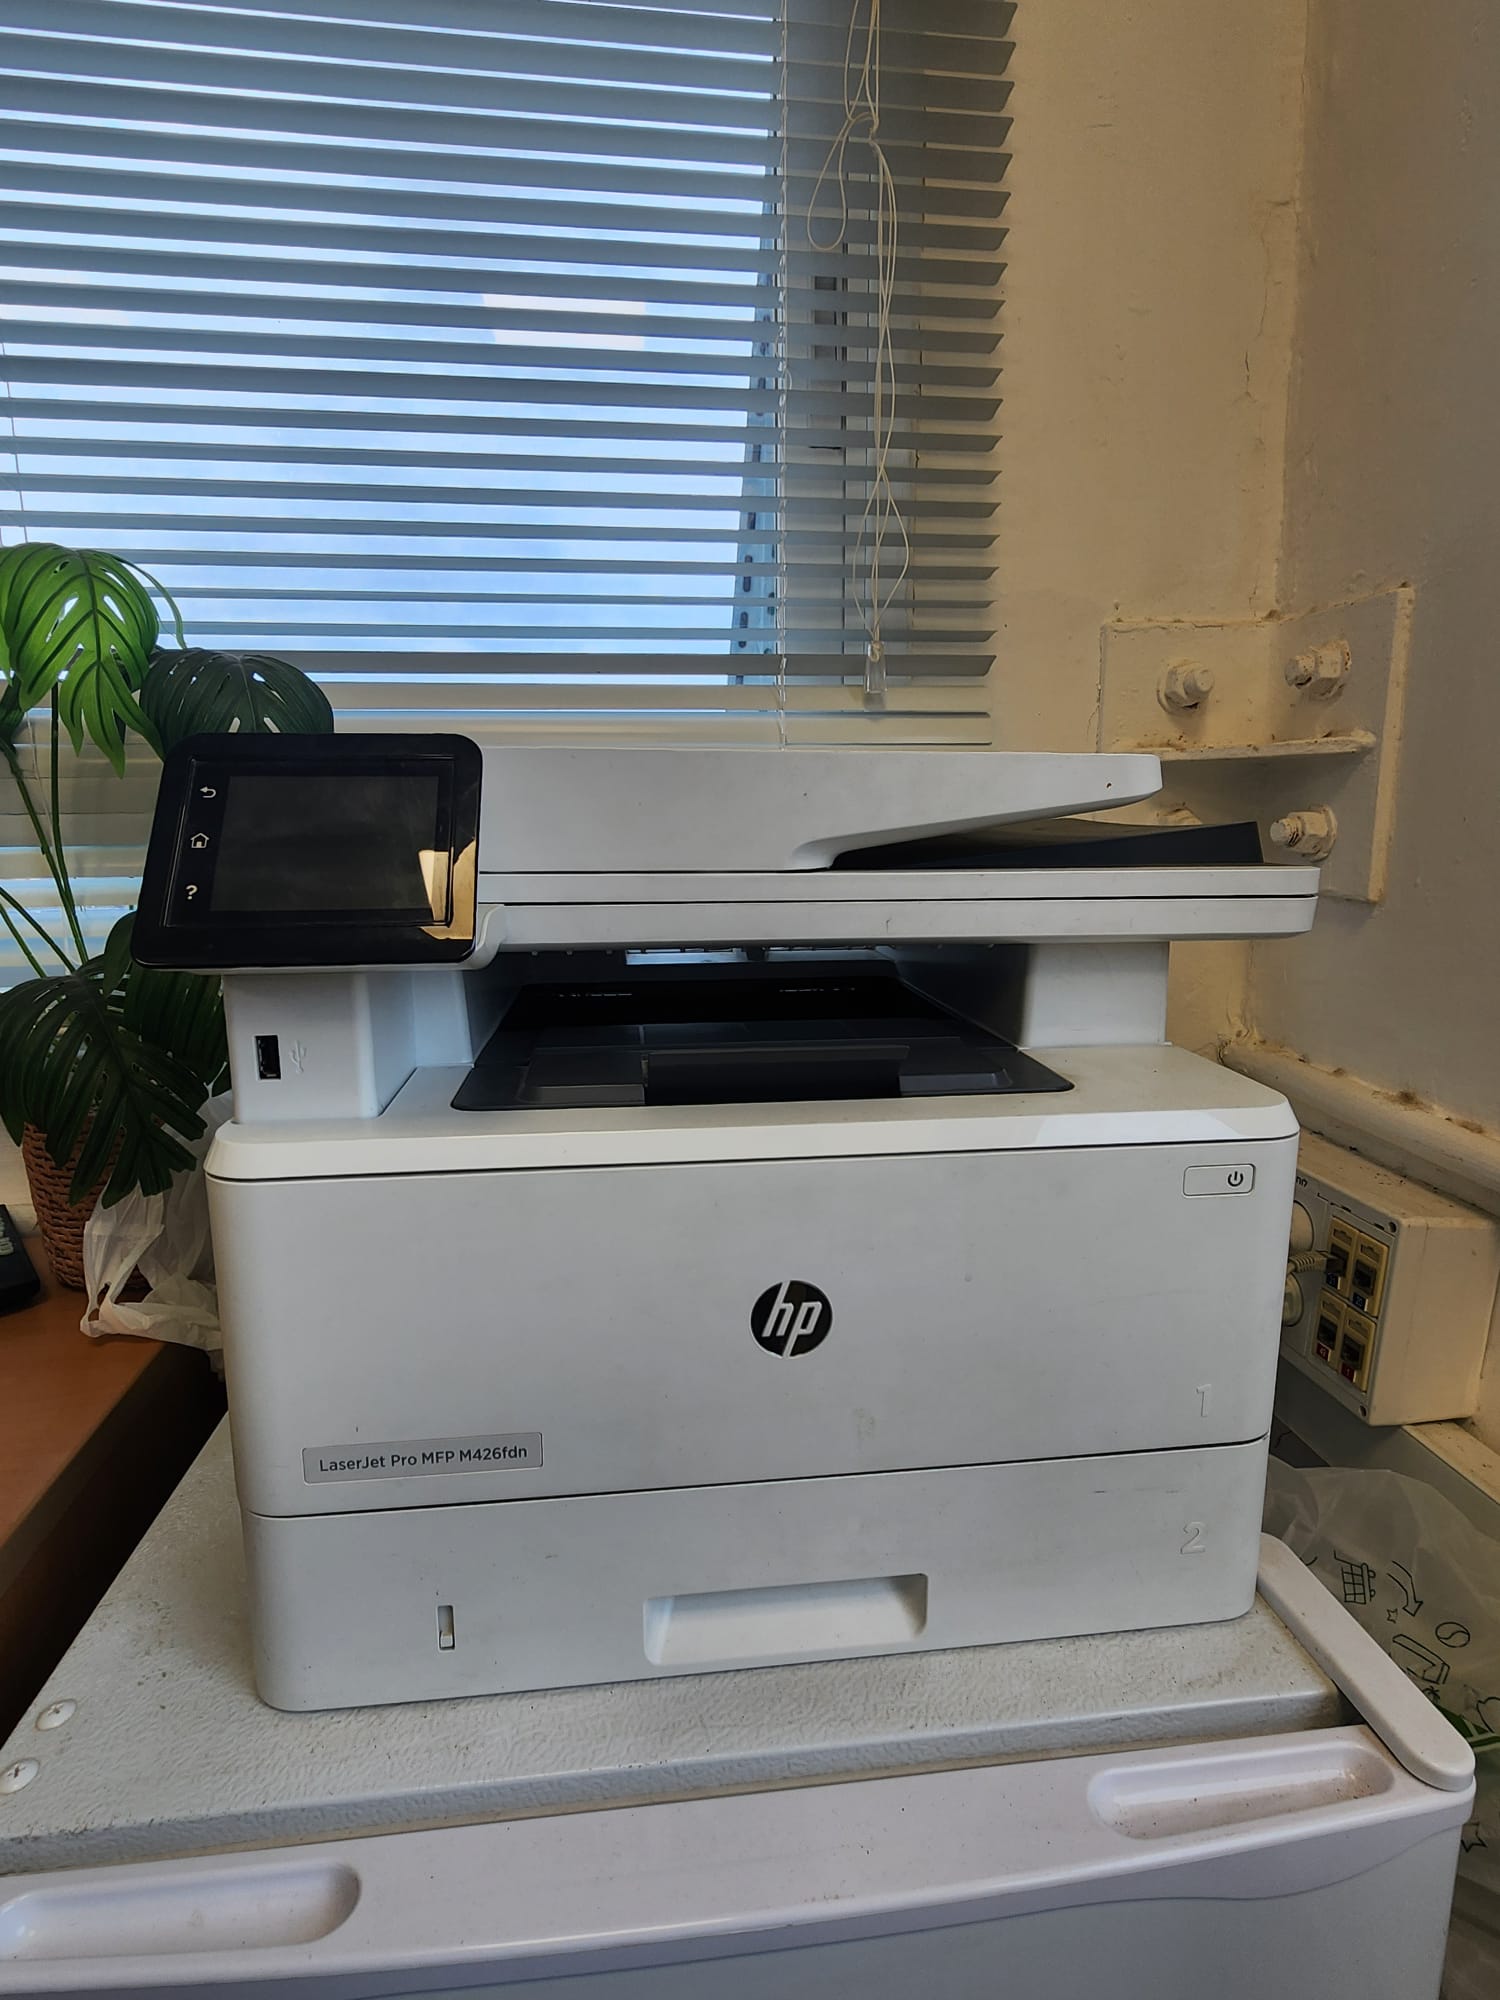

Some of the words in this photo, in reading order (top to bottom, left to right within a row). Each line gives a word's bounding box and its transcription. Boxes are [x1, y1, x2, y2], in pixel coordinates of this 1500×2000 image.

[760, 1279, 823, 1359] hp
[1195, 1383, 1212, 1418] 1
[319, 1455, 386, 1472] LaserJet
[391, 1454, 417, 1467] Pro
[422, 1450, 455, 1465] MFP
[460, 1445, 528, 1462] M426fdn
[1180, 1521, 1206, 1555] 2
